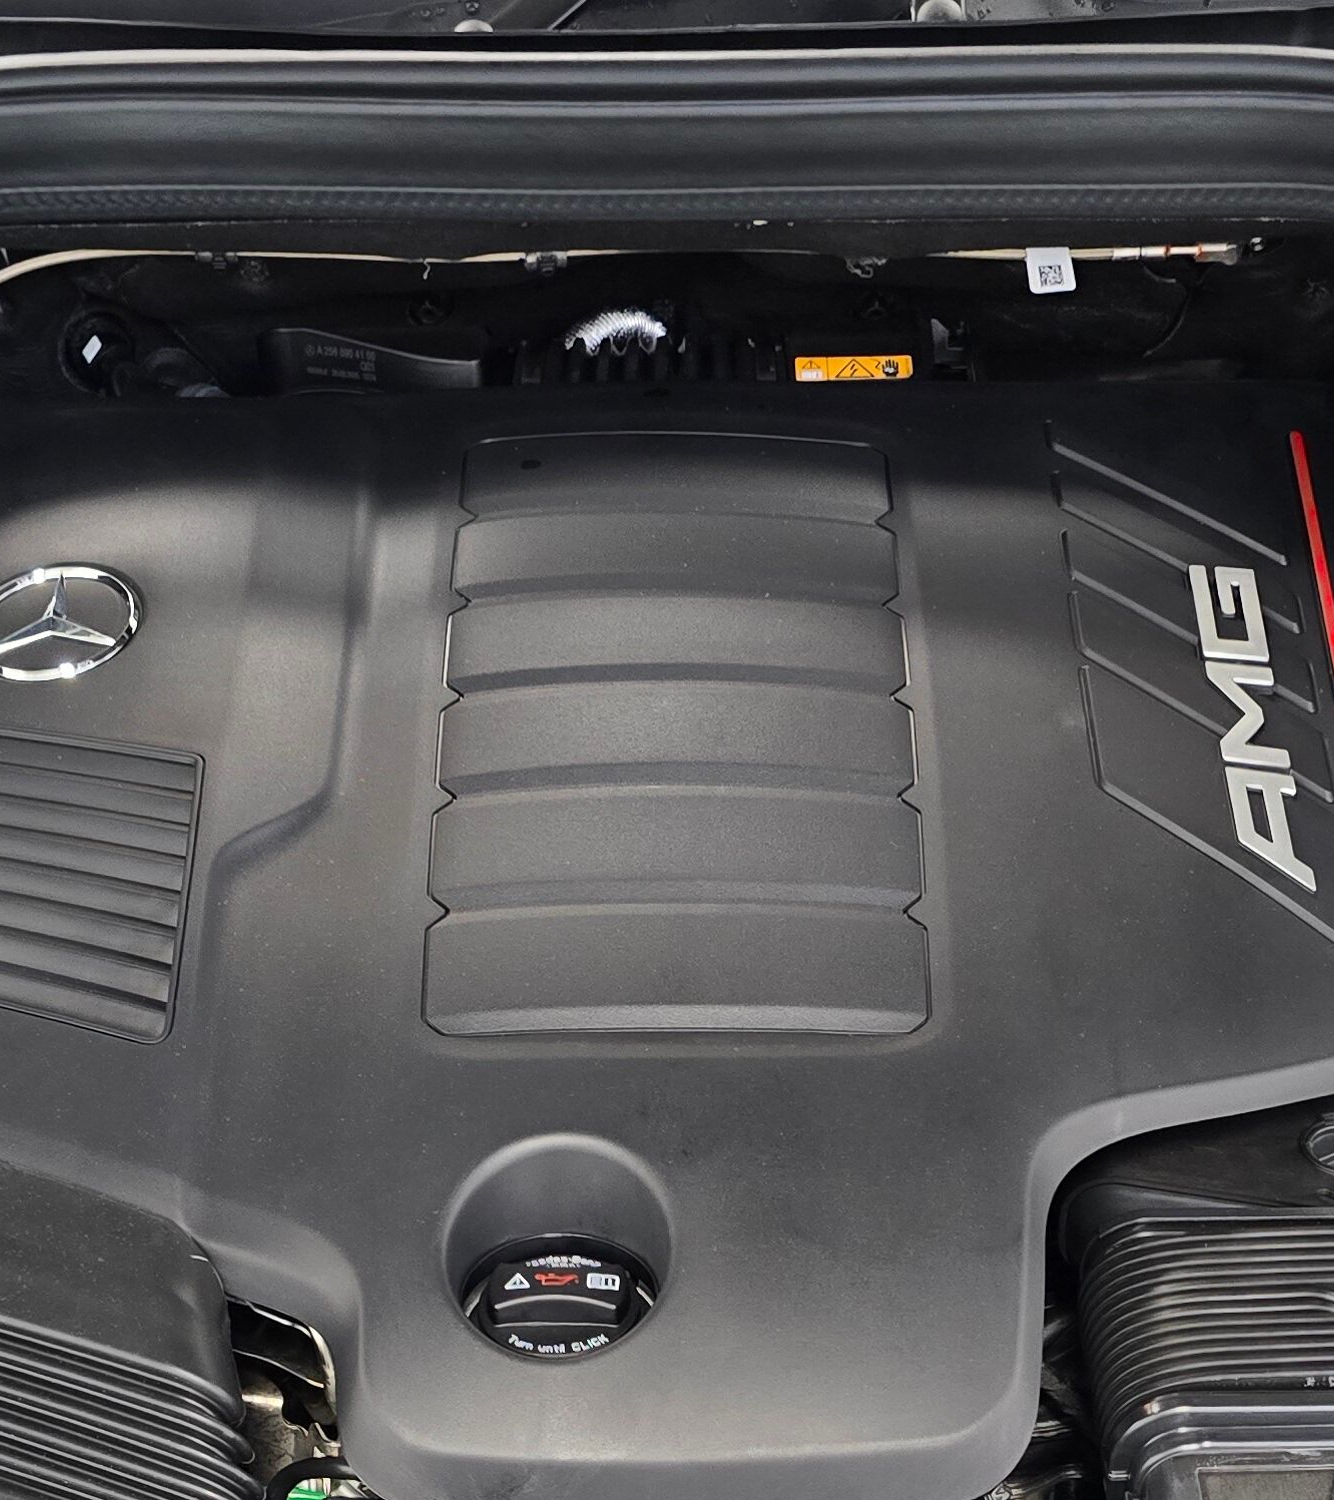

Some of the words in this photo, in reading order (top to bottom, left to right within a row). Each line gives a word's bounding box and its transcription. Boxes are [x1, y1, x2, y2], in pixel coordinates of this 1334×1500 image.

[1188, 564, 1316, 892] AMG
[508, 1334, 534, 1352] Turn
[537, 1342, 566, 1354] until
[571, 1333, 610, 1353] CLICK
